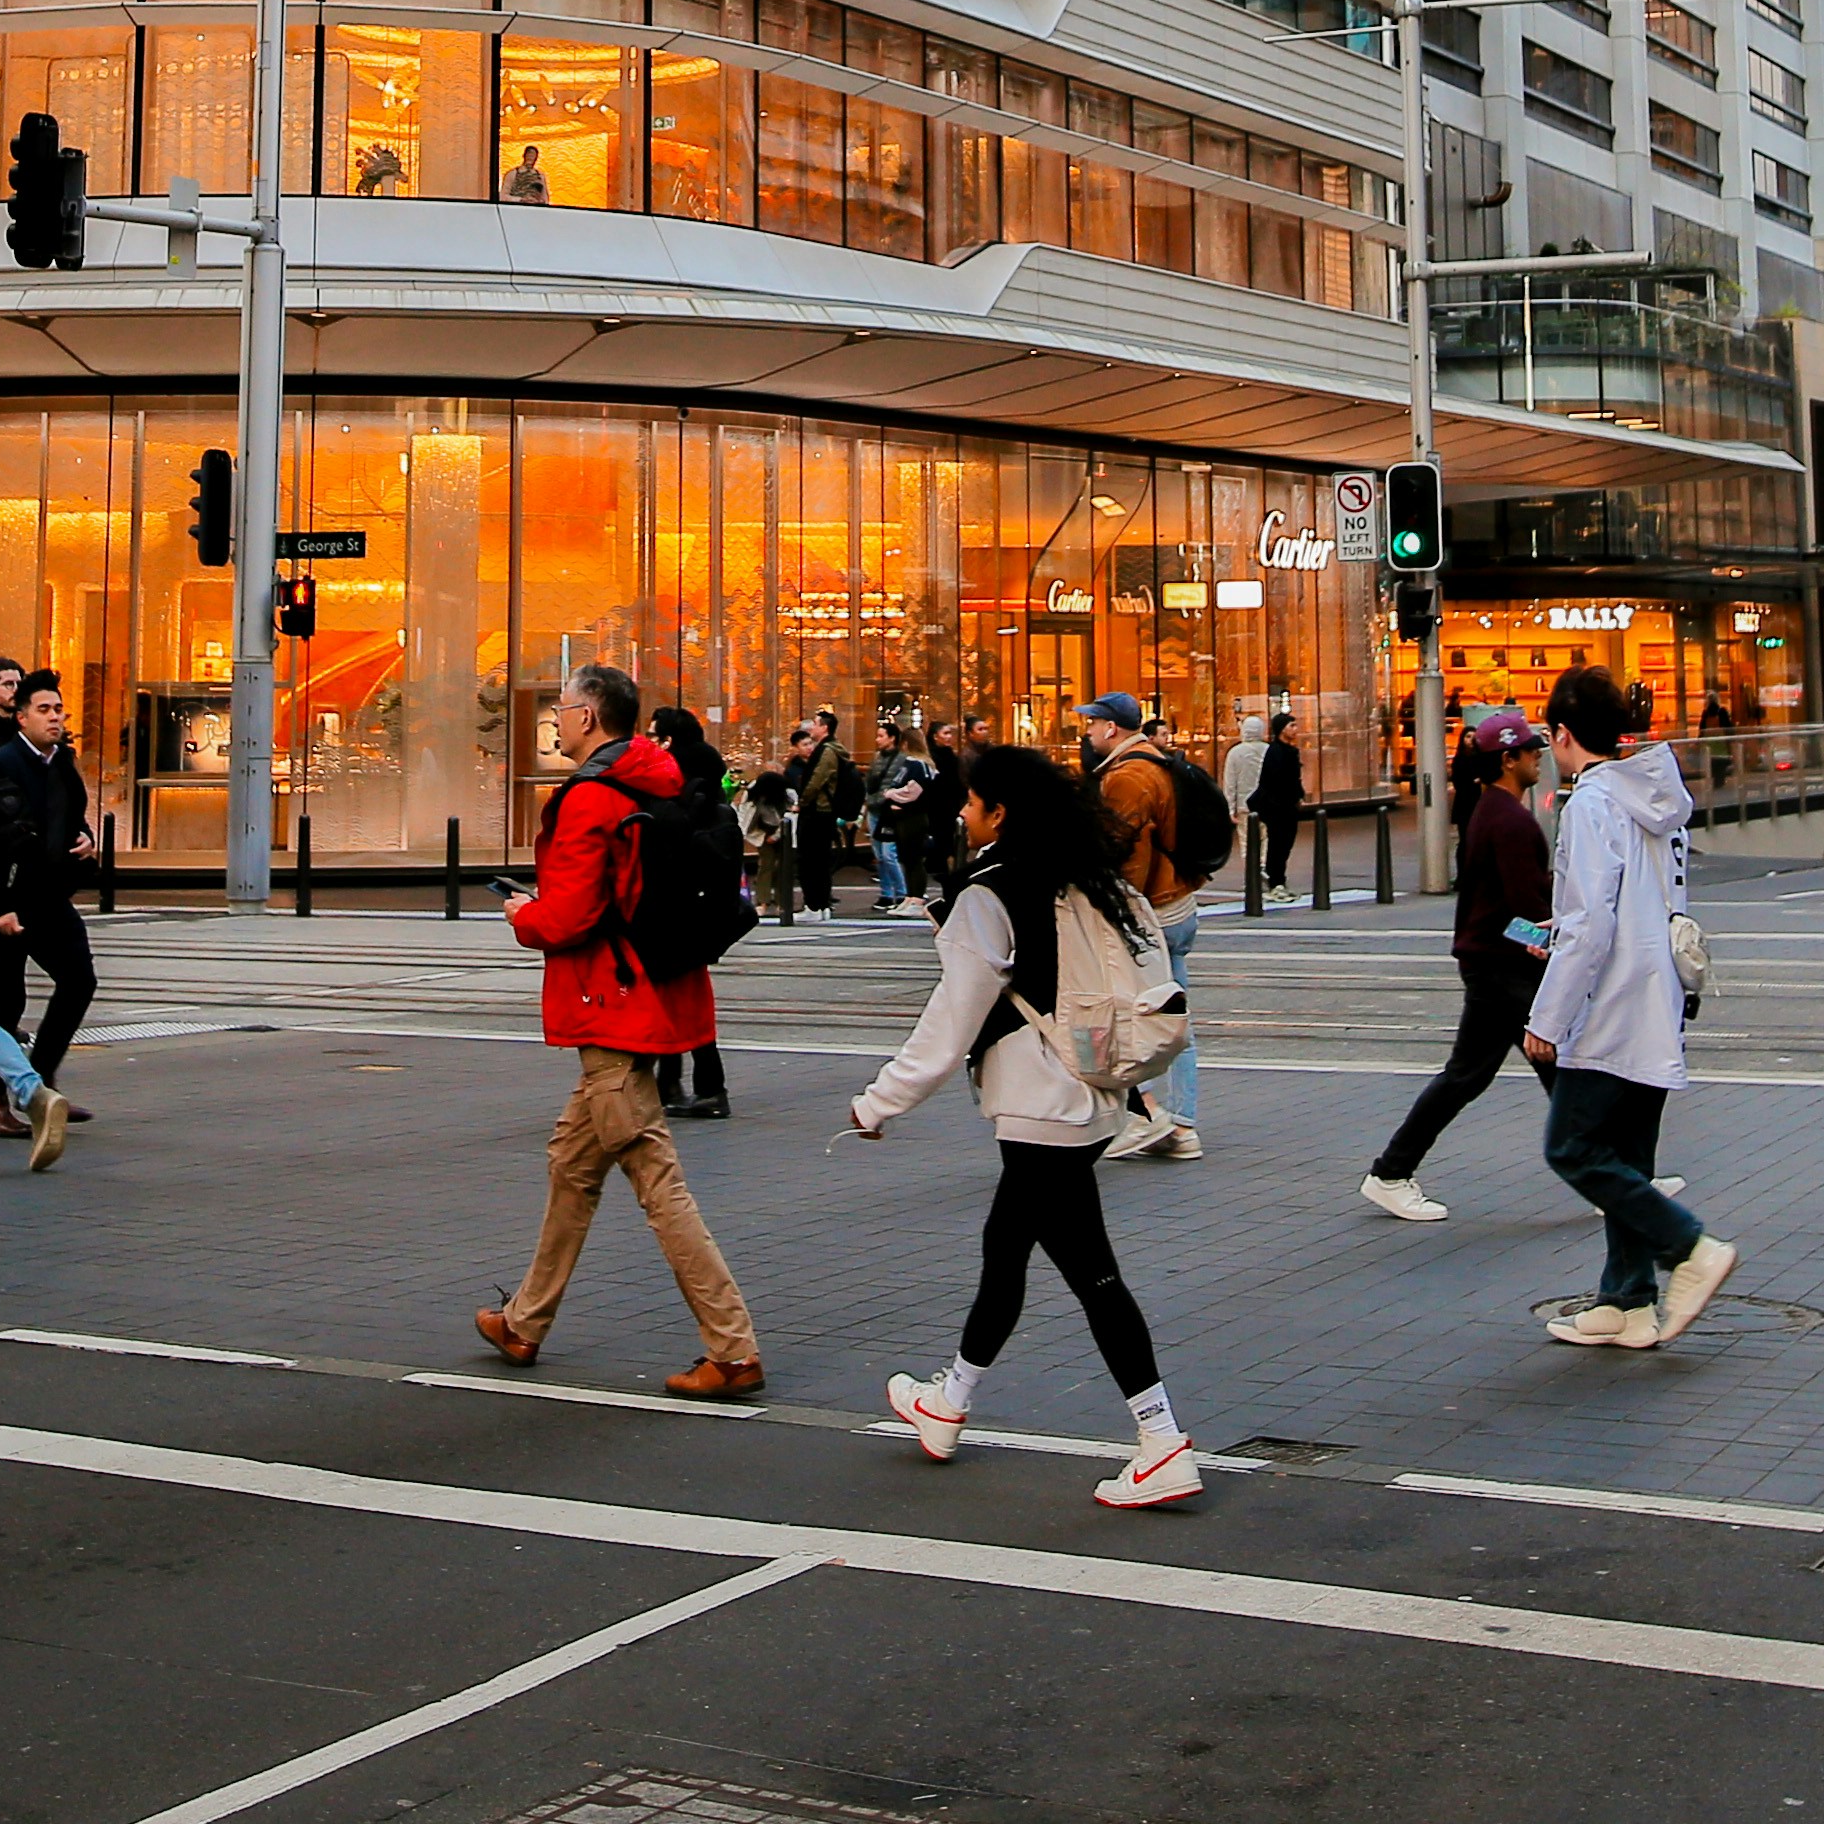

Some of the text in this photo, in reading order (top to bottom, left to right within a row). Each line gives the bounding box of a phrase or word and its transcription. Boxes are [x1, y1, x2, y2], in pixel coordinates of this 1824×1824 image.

[1345, 517, 1367, 530] NO
[297, 537, 360, 555] George St
[1258, 510, 1336, 571] Cartier
[1342, 533, 1370, 544] LEFT
[1341, 545, 1373, 557] TURN
[1046, 579, 1094, 614] Cartier
[1548, 606, 1634, 630] BALLY
